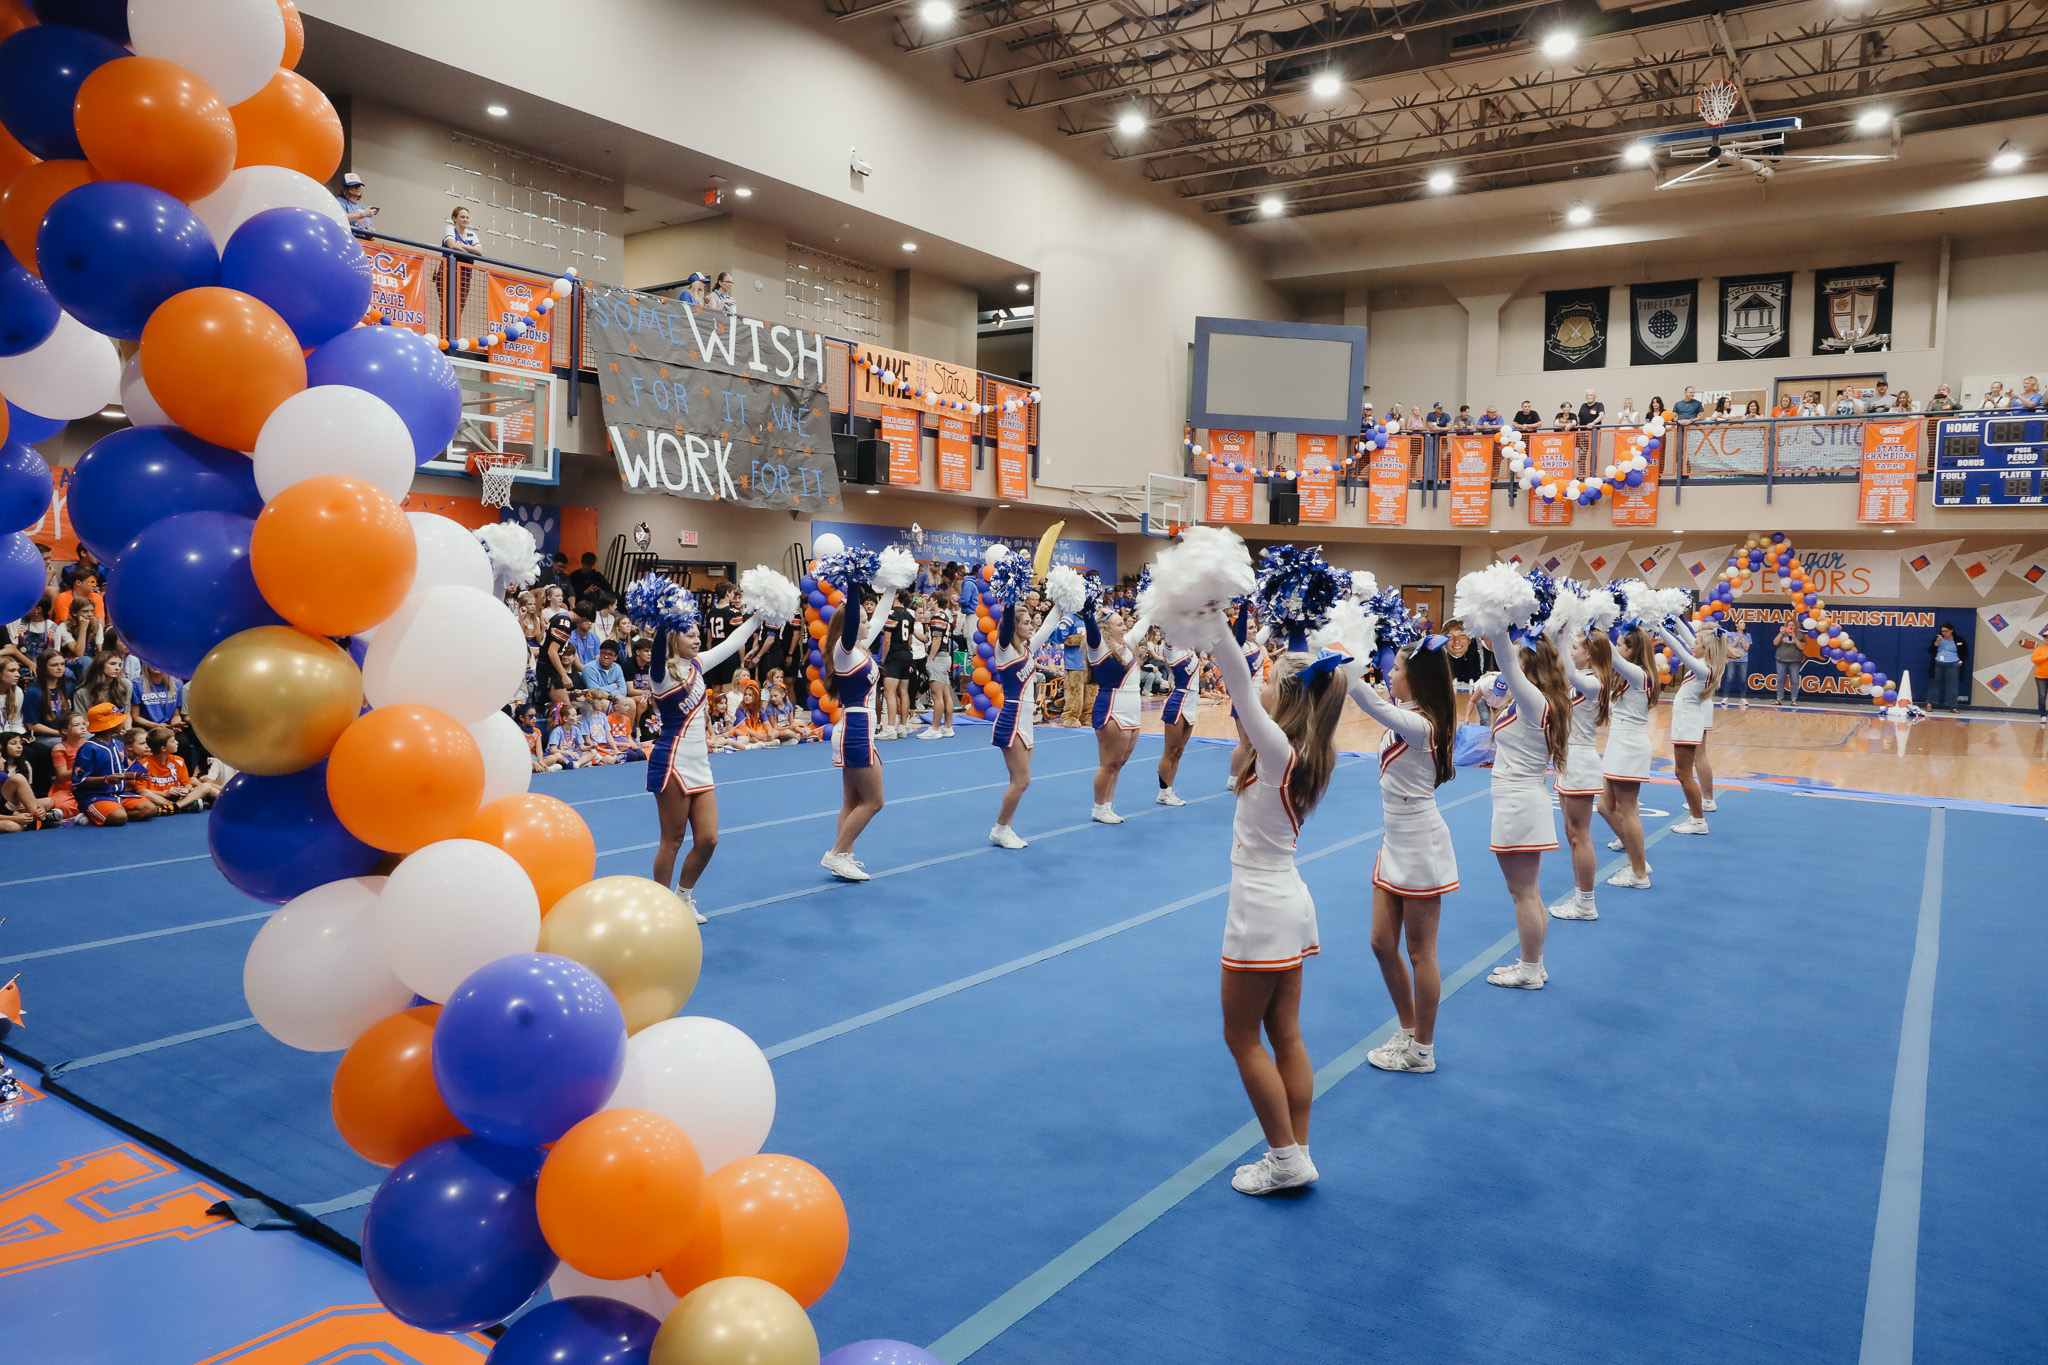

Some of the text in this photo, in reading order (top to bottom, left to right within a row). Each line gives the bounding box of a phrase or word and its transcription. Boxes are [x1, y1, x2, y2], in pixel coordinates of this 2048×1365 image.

[1833, 279, 1875, 287] VERITAS
[1731, 285, 1779, 297] INTEGRITAS
[372, 290, 405, 308] TATE
[1639, 298, 1688, 310] FIDELITAS
[592, 296, 824, 384] SOME WISH
[503, 341, 533, 354] TAPPS
[493, 354, 543, 369] BOYS TRACK
[932, 363, 975, 402] Stars
[631, 376, 811, 438] FOR IT WE
[1946, 423, 1979, 433] HOME
[1219, 432, 1245, 444] CCA
[1865, 452, 1915, 460] CHAMPIONS
[608, 425, 823, 501] WORK FOR IT
[1371, 462, 1407, 470] CHAMPIONS
[1957, 459, 1985, 467] BONUS
[1941, 472, 1966, 480] FOULS
[2000, 471, 2031, 479] PLAYER
[685, 531, 696, 543] EXIT
[900, 530, 911, 540] The
[931, 533, 950, 544] makes
[968, 536, 977, 546] the
[709, 616, 725, 638] 12
[902, 619, 910, 641] 6
